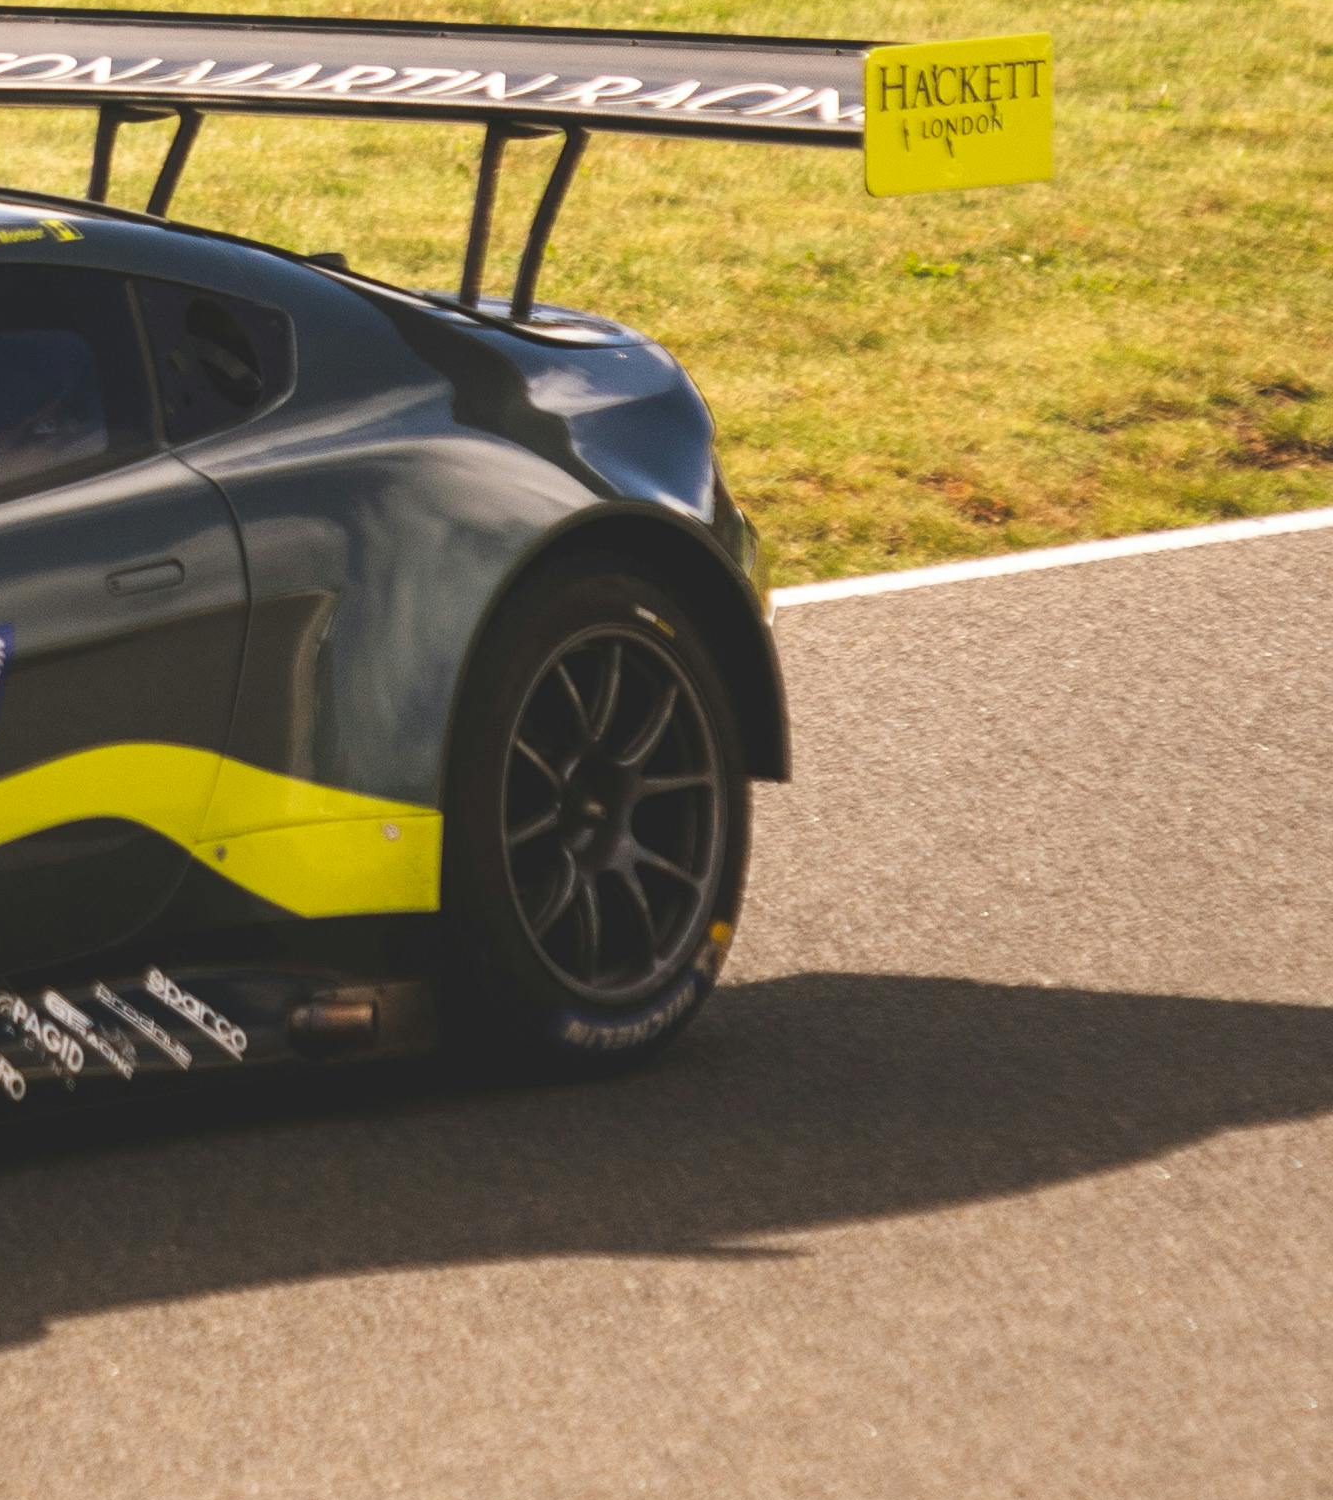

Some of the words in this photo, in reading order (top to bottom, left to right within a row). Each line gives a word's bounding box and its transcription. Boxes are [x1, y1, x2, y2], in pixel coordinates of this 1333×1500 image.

[141, 60, 558, 101] MARTIN
[543, 75, 865, 122] RACIN
[878, 59, 1047, 112] HACKETT
[921, 111, 1005, 143] LONDON
[11, 997, 84, 1074] PAGID
